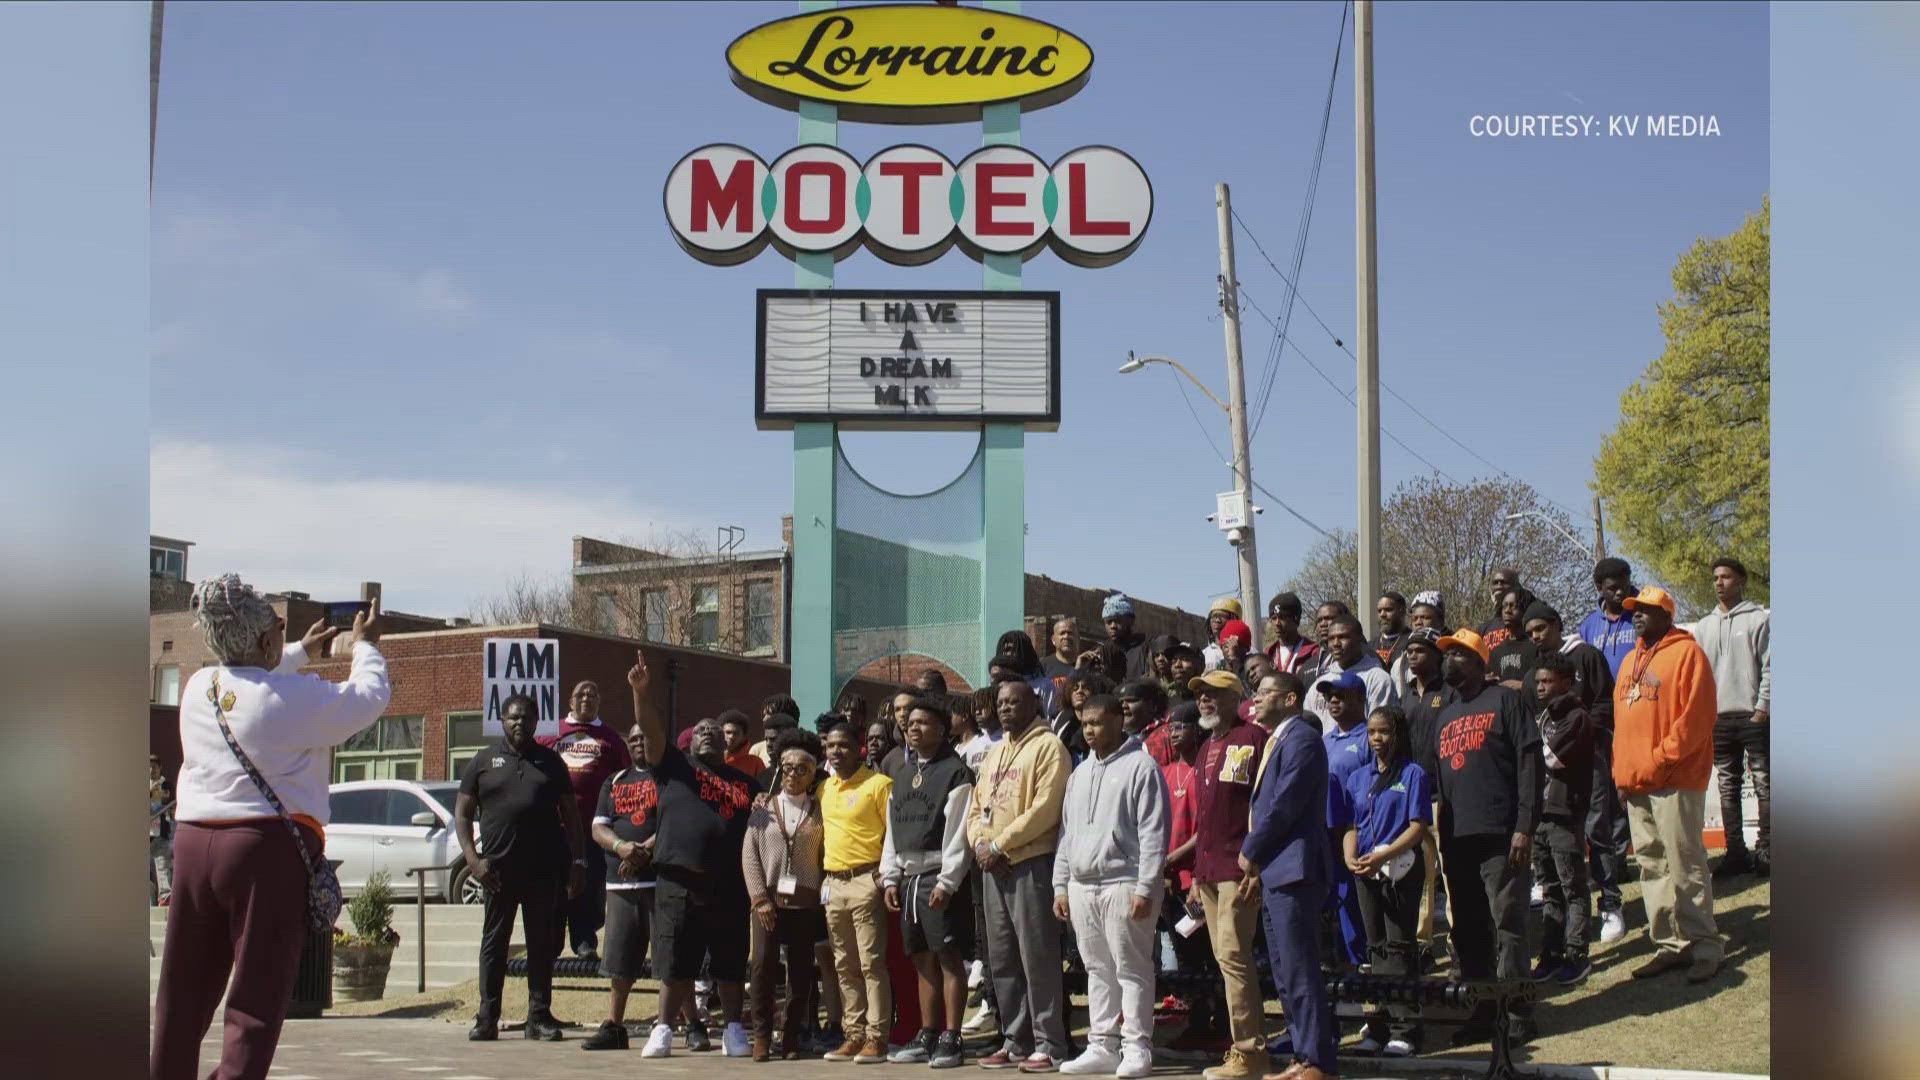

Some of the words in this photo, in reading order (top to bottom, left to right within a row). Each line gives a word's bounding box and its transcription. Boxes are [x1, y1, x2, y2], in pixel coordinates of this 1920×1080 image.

[768, 16, 1060, 92] Lorraine
[690, 159, 1131, 236] MOTEL
[860, 302, 866, 322] I
[885, 302, 957, 323] HAVE
[900, 330, 918, 350] A
[860, 357, 952, 378] DREAM
[875, 385, 930, 405] MLK
[1593, 628, 1636, 649] MEMPHI
[487, 643, 496, 678] I
[505, 643, 554, 679] AM
[488, 684, 501, 721] A
[1452, 717, 1465, 737] THE
[1464, 712, 1496, 732] BLIGHT
[556, 741, 600, 756] MELROSE
[1440, 736, 1460, 759] BOOT
[1459, 730, 1485, 752] CAMP
[1219, 745, 1255, 784] M
[615, 797, 639, 814] BOOT
[639, 790, 658, 811] CAM
